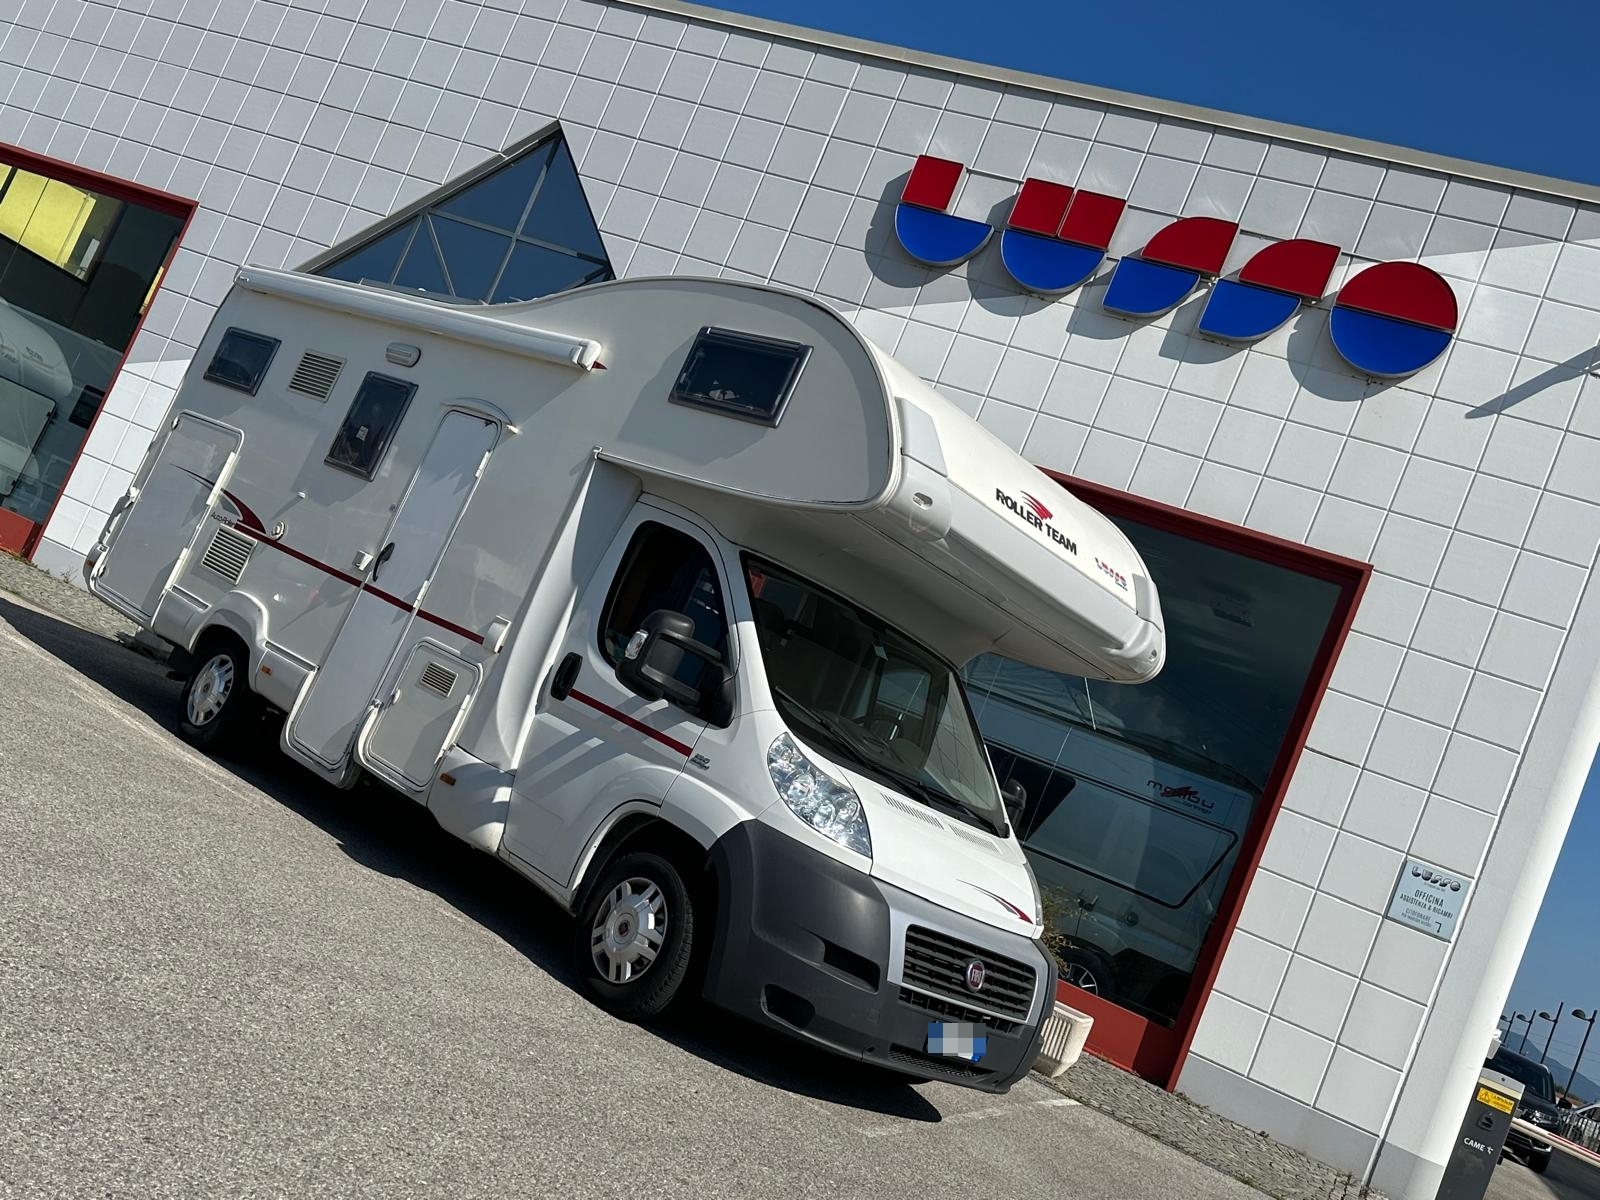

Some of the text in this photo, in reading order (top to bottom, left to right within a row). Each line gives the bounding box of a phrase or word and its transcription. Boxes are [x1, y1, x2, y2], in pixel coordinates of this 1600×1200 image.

[995, 488, 1078, 555] ROLLER TEAM
[1400, 893, 1427, 909] ASSISTENZA
[1414, 889, 1444, 907] OFFICINA
[1463, 1137, 1486, 1151] CAME
